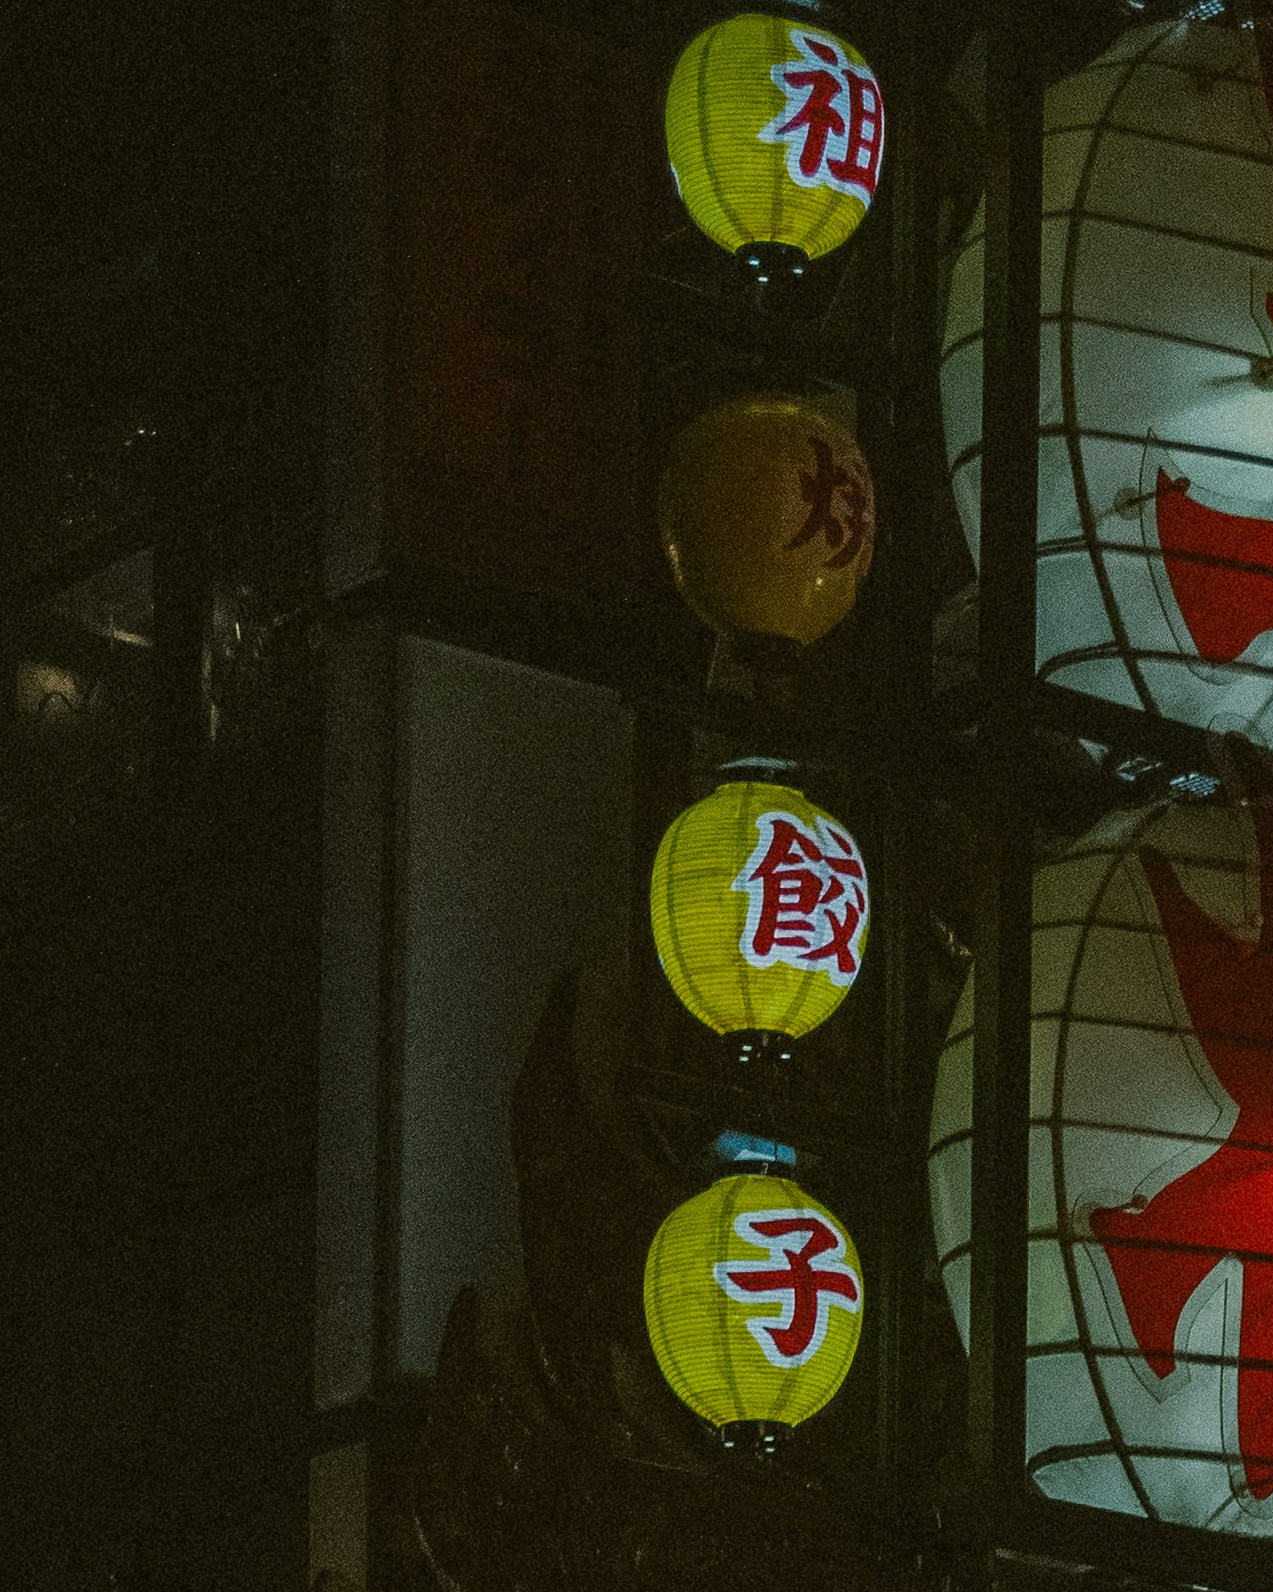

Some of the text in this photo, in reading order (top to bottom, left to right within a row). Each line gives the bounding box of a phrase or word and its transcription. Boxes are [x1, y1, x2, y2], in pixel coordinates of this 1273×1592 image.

[776, 36, 884, 196] 祖
[754, 818, 868, 974] 餃
[726, 1215, 858, 1359] 子
